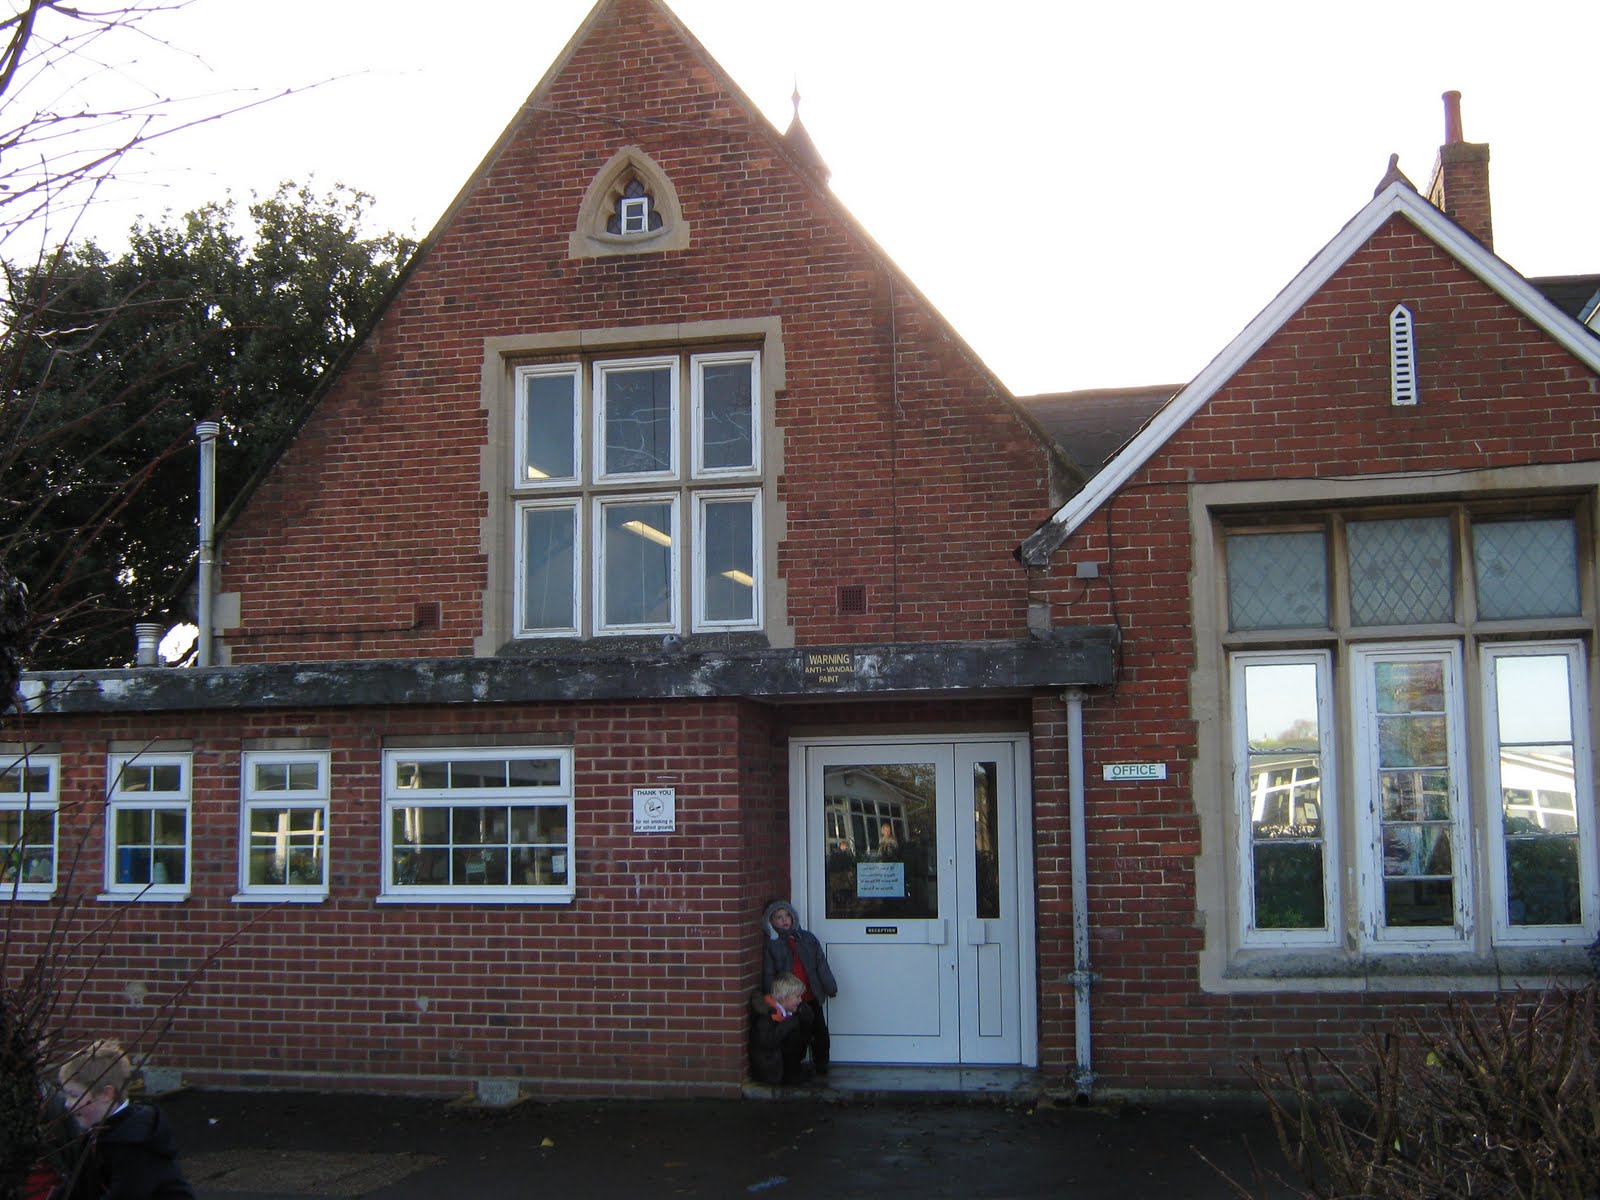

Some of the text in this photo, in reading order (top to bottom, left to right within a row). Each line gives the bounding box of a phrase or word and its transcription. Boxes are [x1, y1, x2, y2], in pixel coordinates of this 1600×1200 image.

[809, 654, 850, 665] WARNING
[818, 675, 839, 683] PAINT
[1112, 765, 1157, 776] OFFICE
